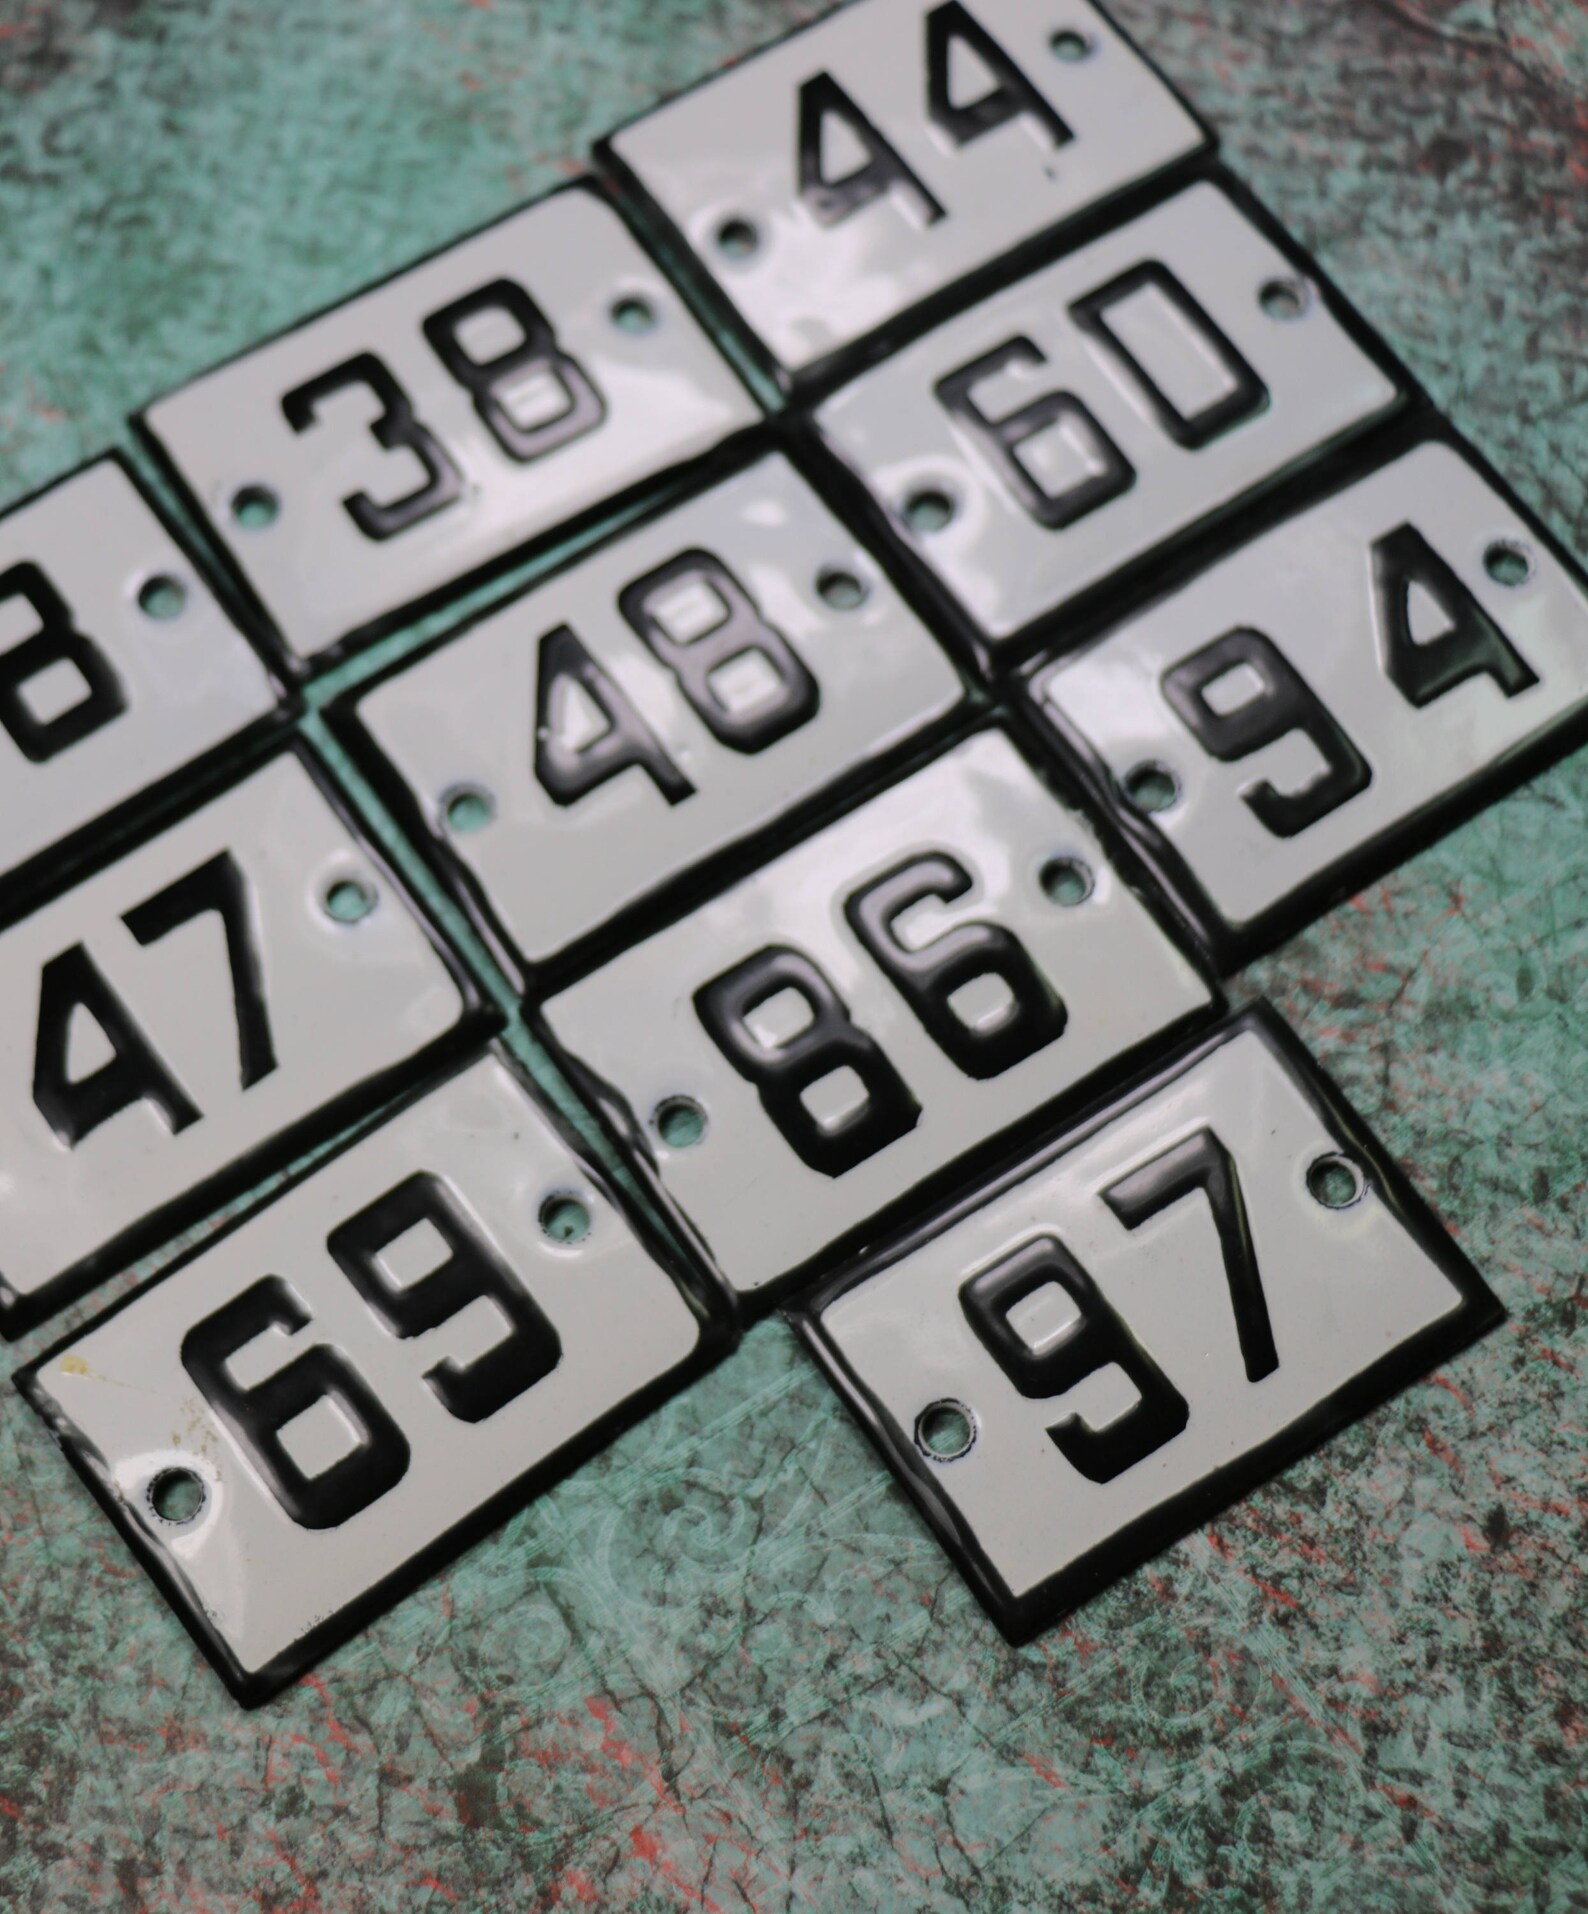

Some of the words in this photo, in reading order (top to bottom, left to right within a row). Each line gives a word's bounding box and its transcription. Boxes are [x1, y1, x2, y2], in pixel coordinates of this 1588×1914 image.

[797, 0, 1074, 229] 44
[282, 277, 607, 540] 38
[936, 259, 1269, 529] 60
[535, 547, 817, 807] 48
[1162, 521, 1540, 838] 94
[32, 849, 279, 1147] 47
[692, 850, 1067, 1177] 86
[181, 1170, 562, 1530] 69
[959, 1126, 1279, 1484] 97
